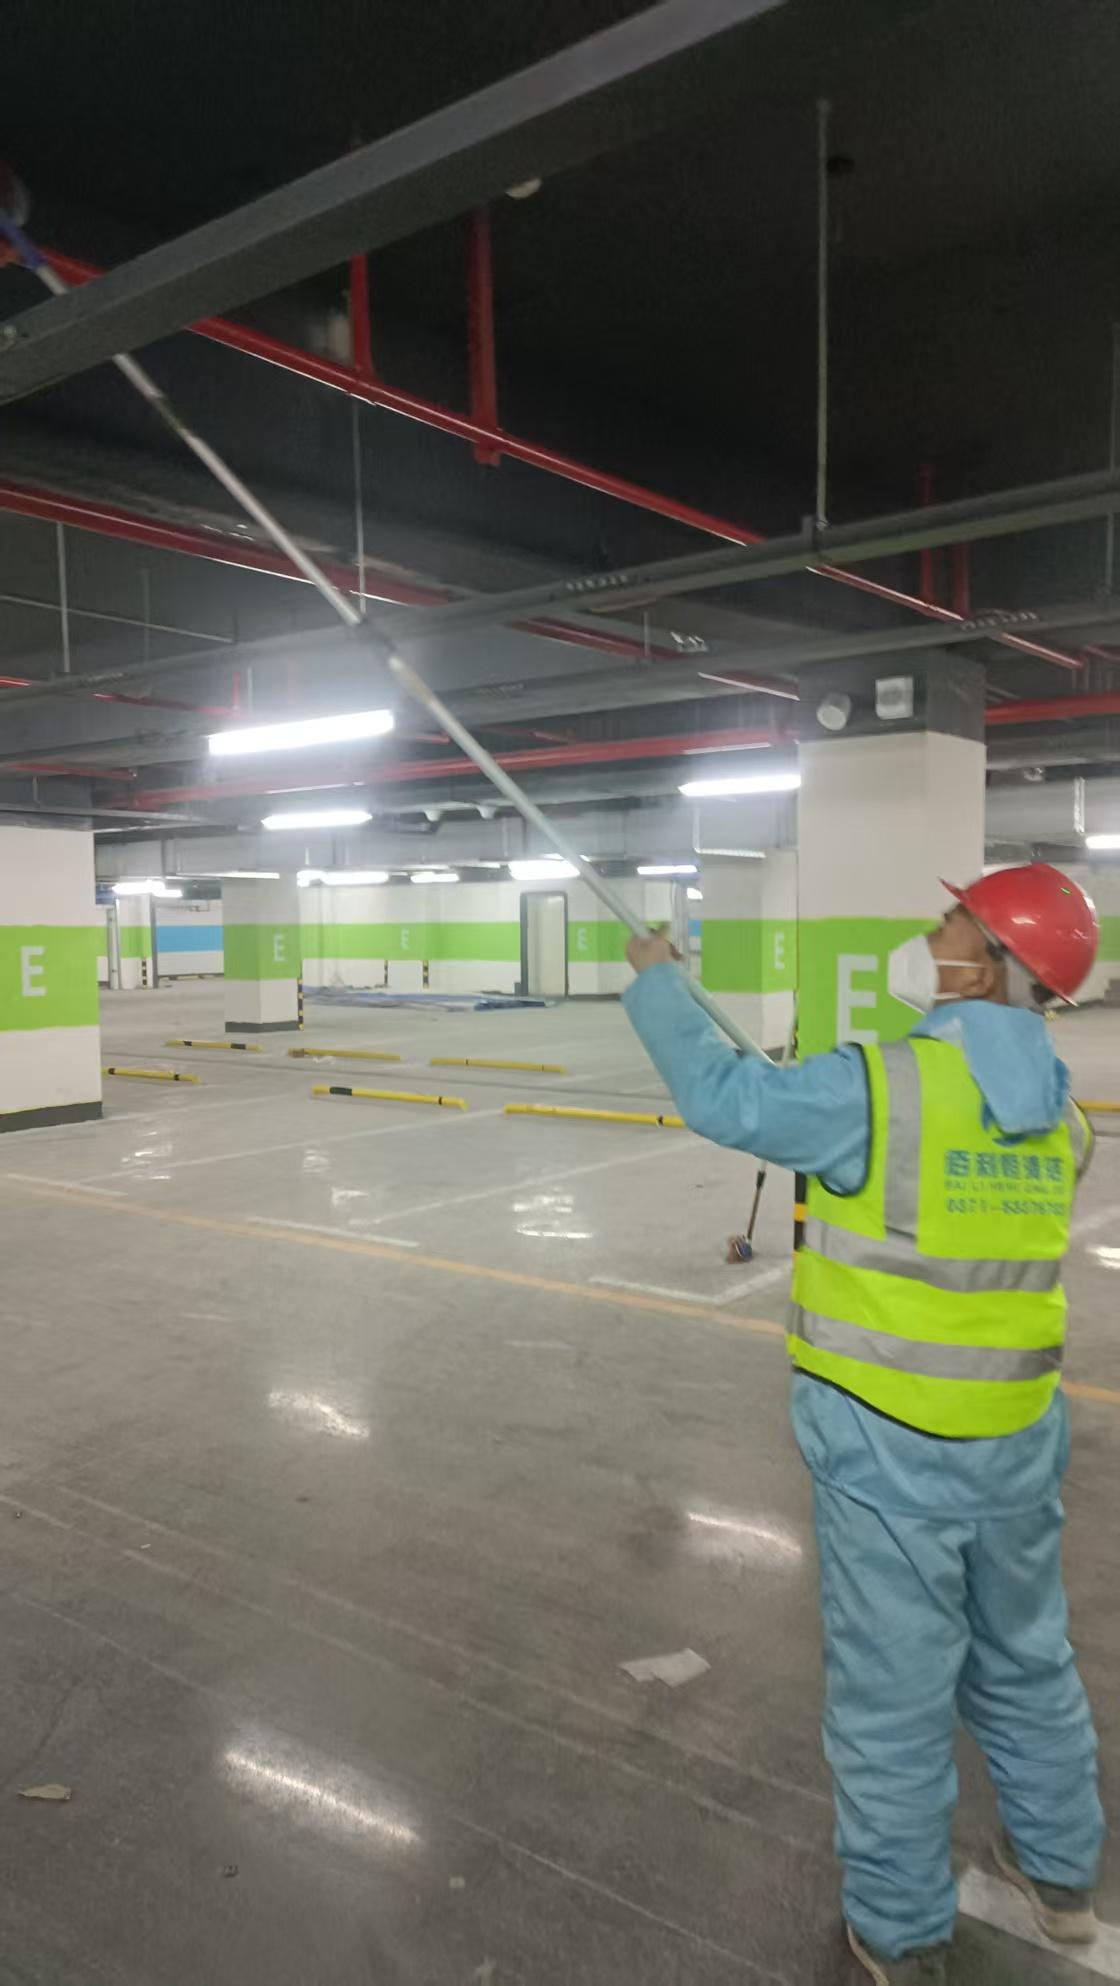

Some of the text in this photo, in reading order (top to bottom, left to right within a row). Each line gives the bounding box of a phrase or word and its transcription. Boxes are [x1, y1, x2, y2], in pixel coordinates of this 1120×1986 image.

[273, 934, 285, 962] E
[773, 932, 785, 970] E
[20, 945, 47, 997] E
[836, 953, 879, 1047] E
